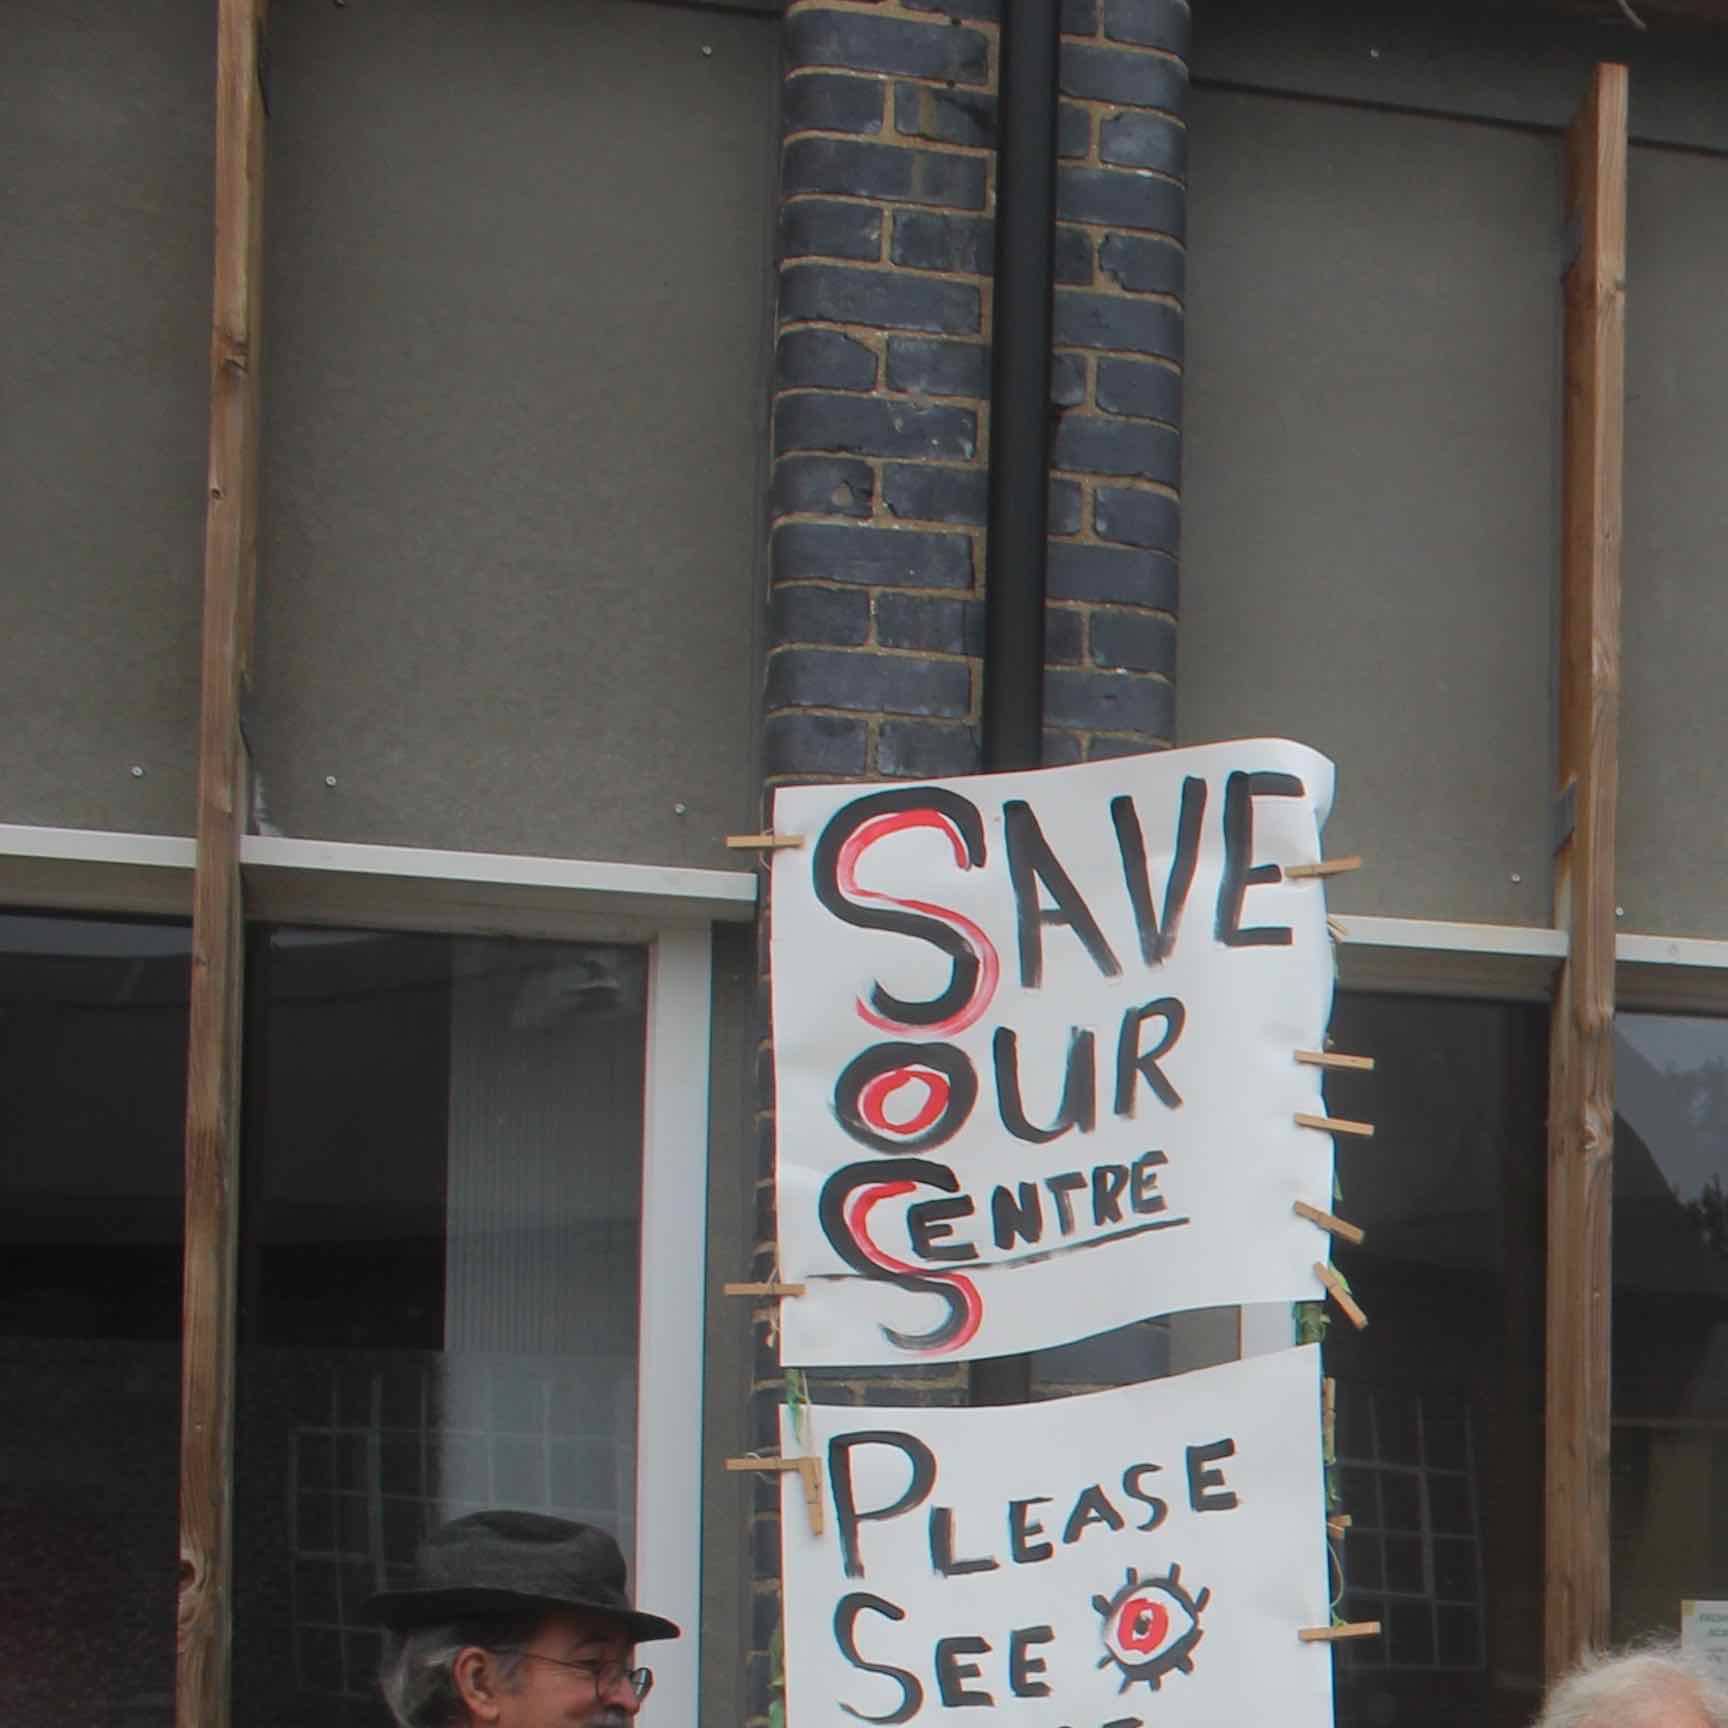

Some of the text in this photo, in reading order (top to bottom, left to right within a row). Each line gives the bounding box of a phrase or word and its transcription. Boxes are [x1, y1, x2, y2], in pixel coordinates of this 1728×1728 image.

[812, 770, 1305, 1036] SAVE
[832, 996, 1184, 1155] OUR
[827, 1429, 1242, 1578] PLEASE
[832, 1591, 1056, 1725] SEE
